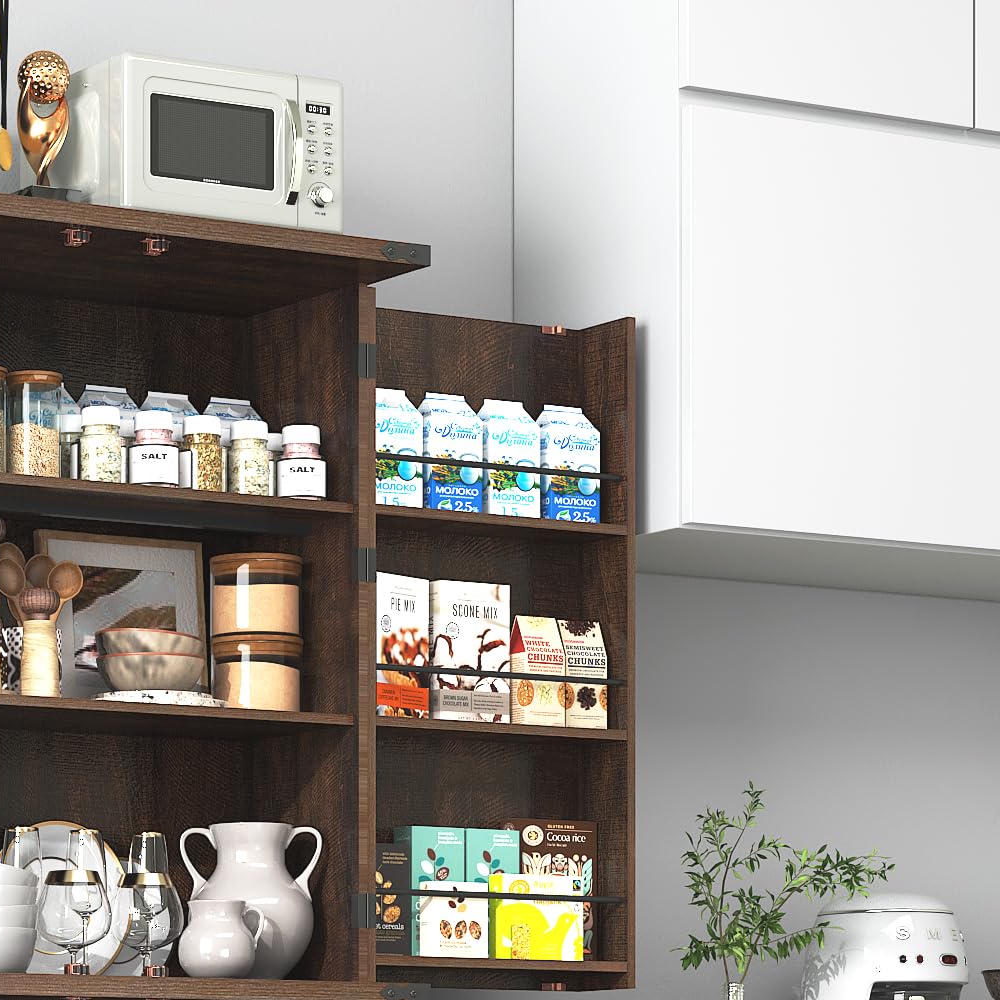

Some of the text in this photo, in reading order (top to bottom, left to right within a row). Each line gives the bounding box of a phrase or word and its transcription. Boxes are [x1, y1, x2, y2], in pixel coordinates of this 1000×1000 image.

[435, 486, 479, 497] МОЛОКО
[492, 493, 535, 503] МОЛОКО
[554, 496, 597, 507] МОЛОКО
[390, 597, 416, 613] PIE MIX
[452, 603, 498, 620] SCONE MIX
[527, 653, 564, 663] CHUNKS
[567, 657, 606, 666] CHUNKS
[546, 832, 587, 843] Cocoa rice
